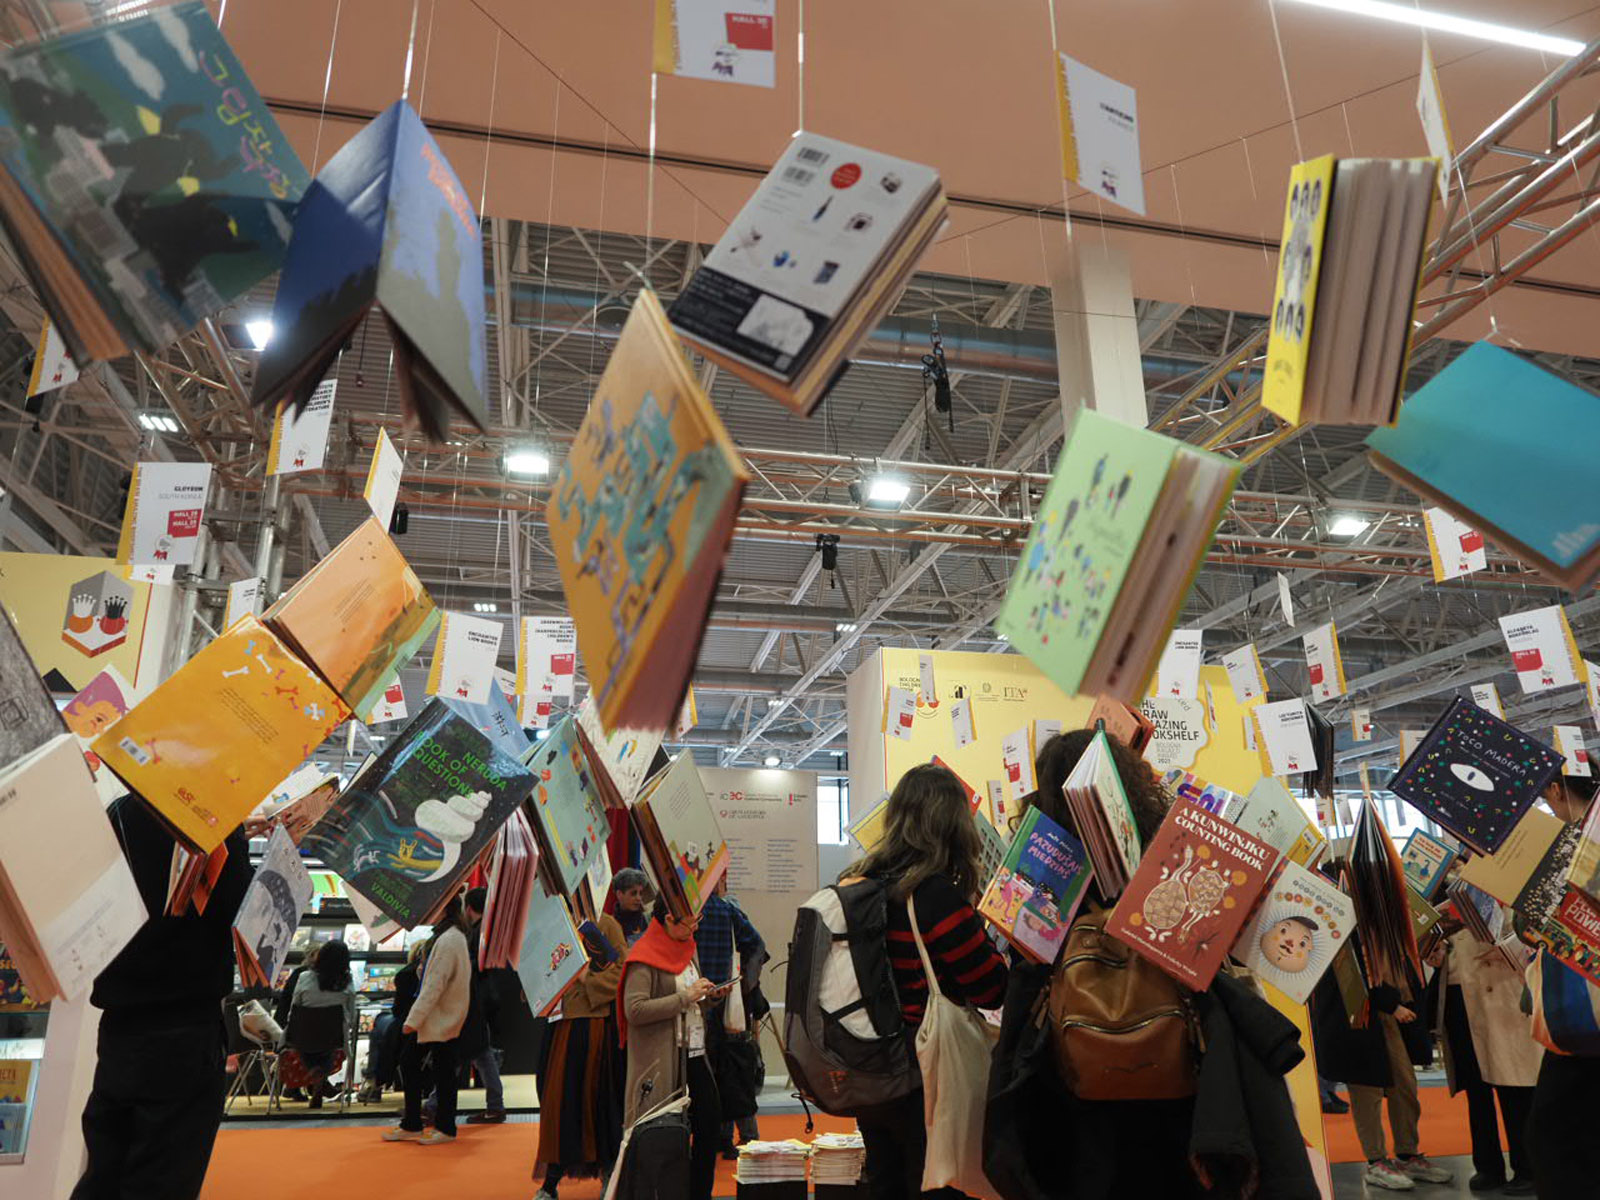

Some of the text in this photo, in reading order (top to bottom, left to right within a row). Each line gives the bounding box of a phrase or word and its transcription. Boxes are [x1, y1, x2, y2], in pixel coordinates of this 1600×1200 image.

[1141, 709, 1168, 719] RAW
[1151, 719, 1188, 731] AZING
[1152, 729, 1200, 741] OKSHELF
[1458, 730, 1483, 749] TOCO
[1484, 748, 1527, 777] MADERA
[412, 747, 475, 799] QUESTIONS
[450, 759, 468, 774] OF
[462, 751, 507, 791] NERUDA
[1174, 815, 1264, 871] COUNTING BOOK
[1179, 807, 1271, 860] A KUNWINJKU
[371, 882, 411, 919] VALDIVIA
[1564, 904, 1600, 937] POWE
